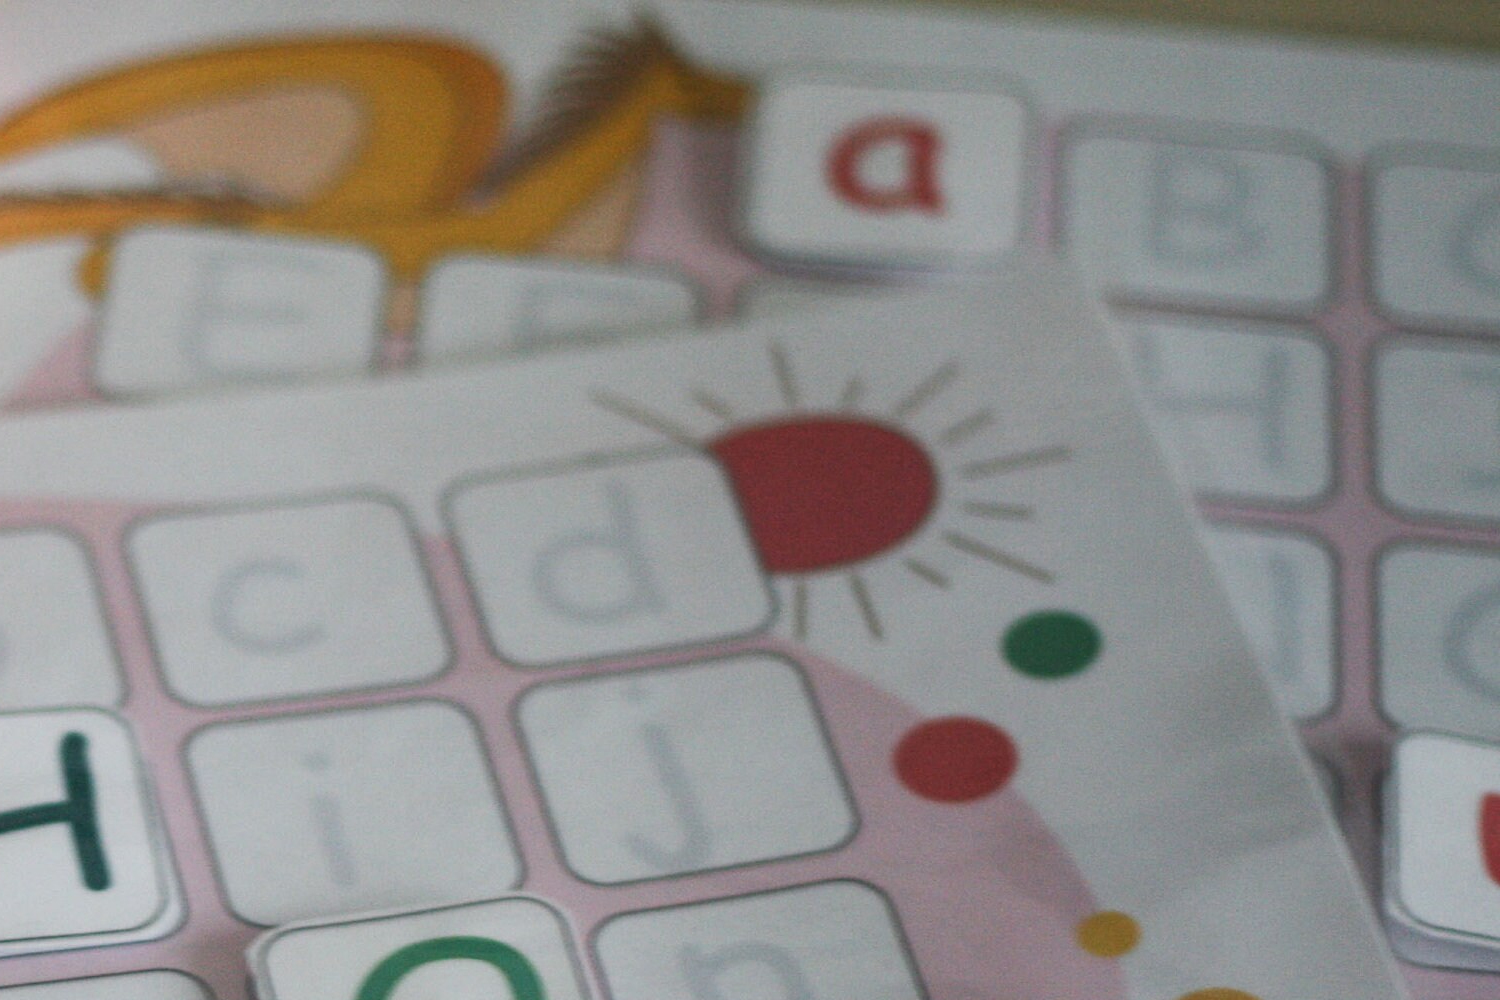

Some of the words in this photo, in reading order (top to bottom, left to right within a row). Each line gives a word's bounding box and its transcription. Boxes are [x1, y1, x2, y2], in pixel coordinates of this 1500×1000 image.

[1150, 147, 1267, 264] B
[212, 557, 326, 656] c
[531, 478, 670, 626] d
[303, 752, 355, 889] i
